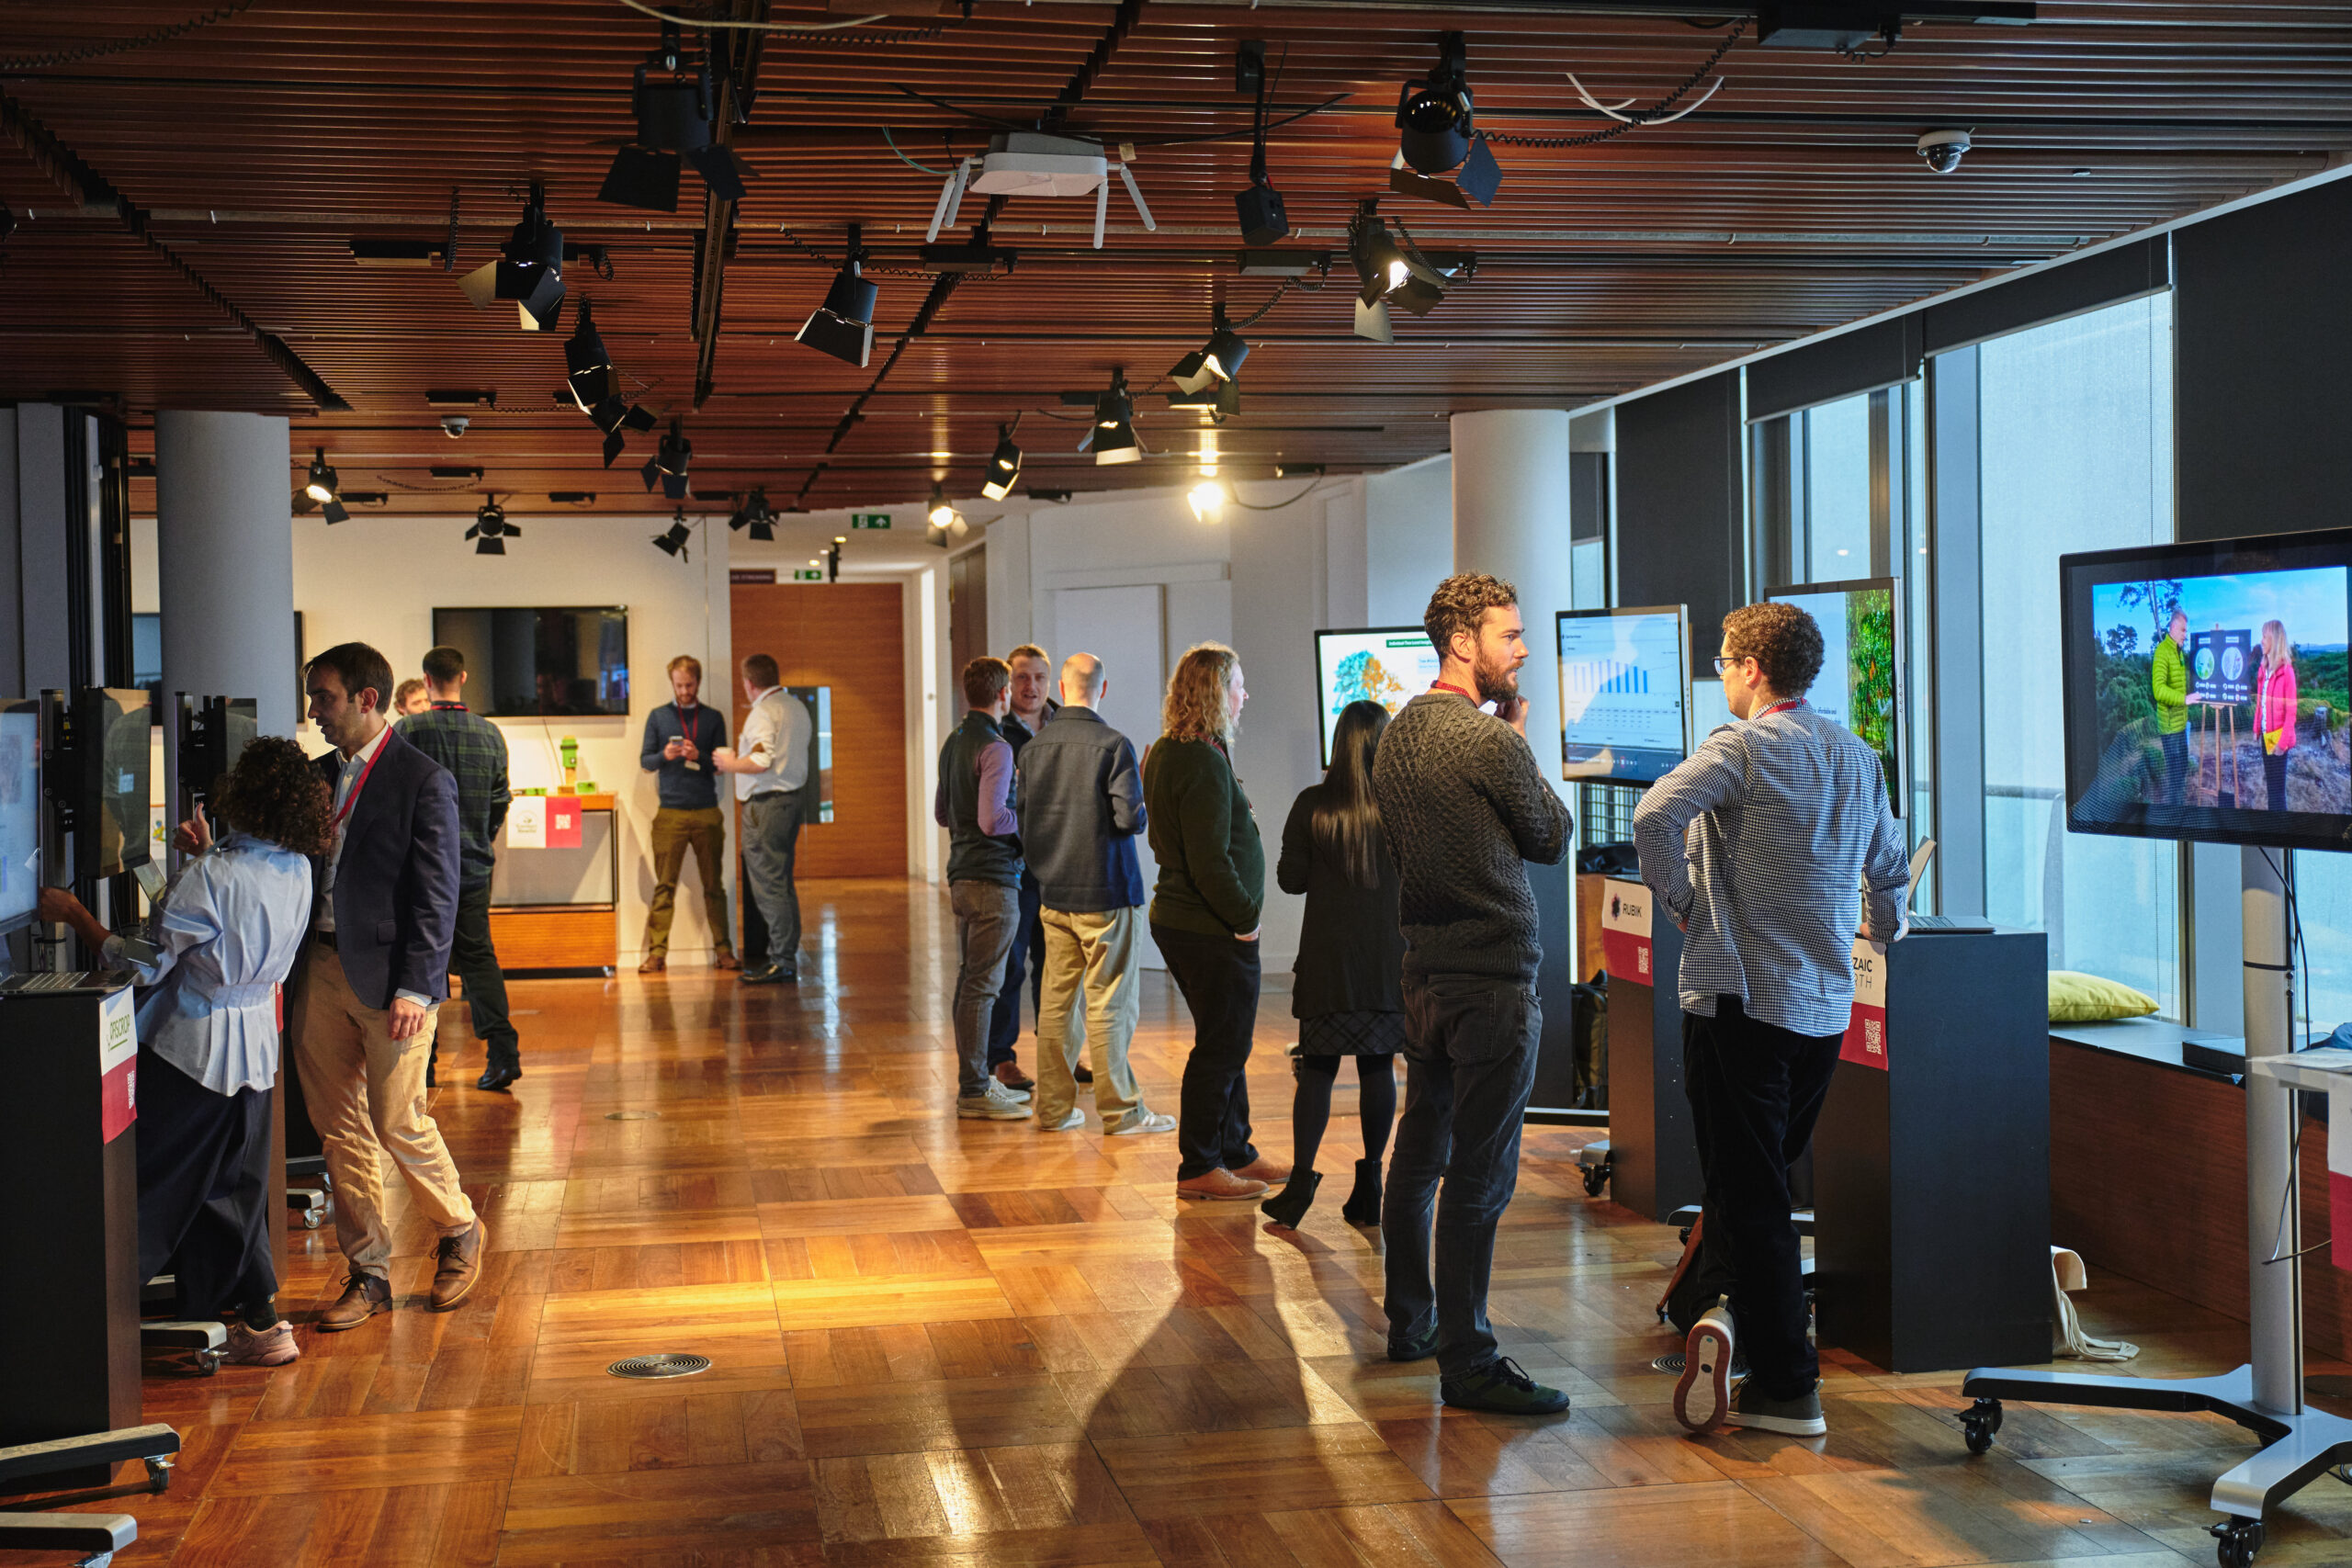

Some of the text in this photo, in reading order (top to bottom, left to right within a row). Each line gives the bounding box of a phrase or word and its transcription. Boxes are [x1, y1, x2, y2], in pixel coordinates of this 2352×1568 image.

[1623, 903, 1642, 918] RUBIK
[1852, 956, 1872, 973] ZAIC
[1854, 973, 1872, 989] RTH
